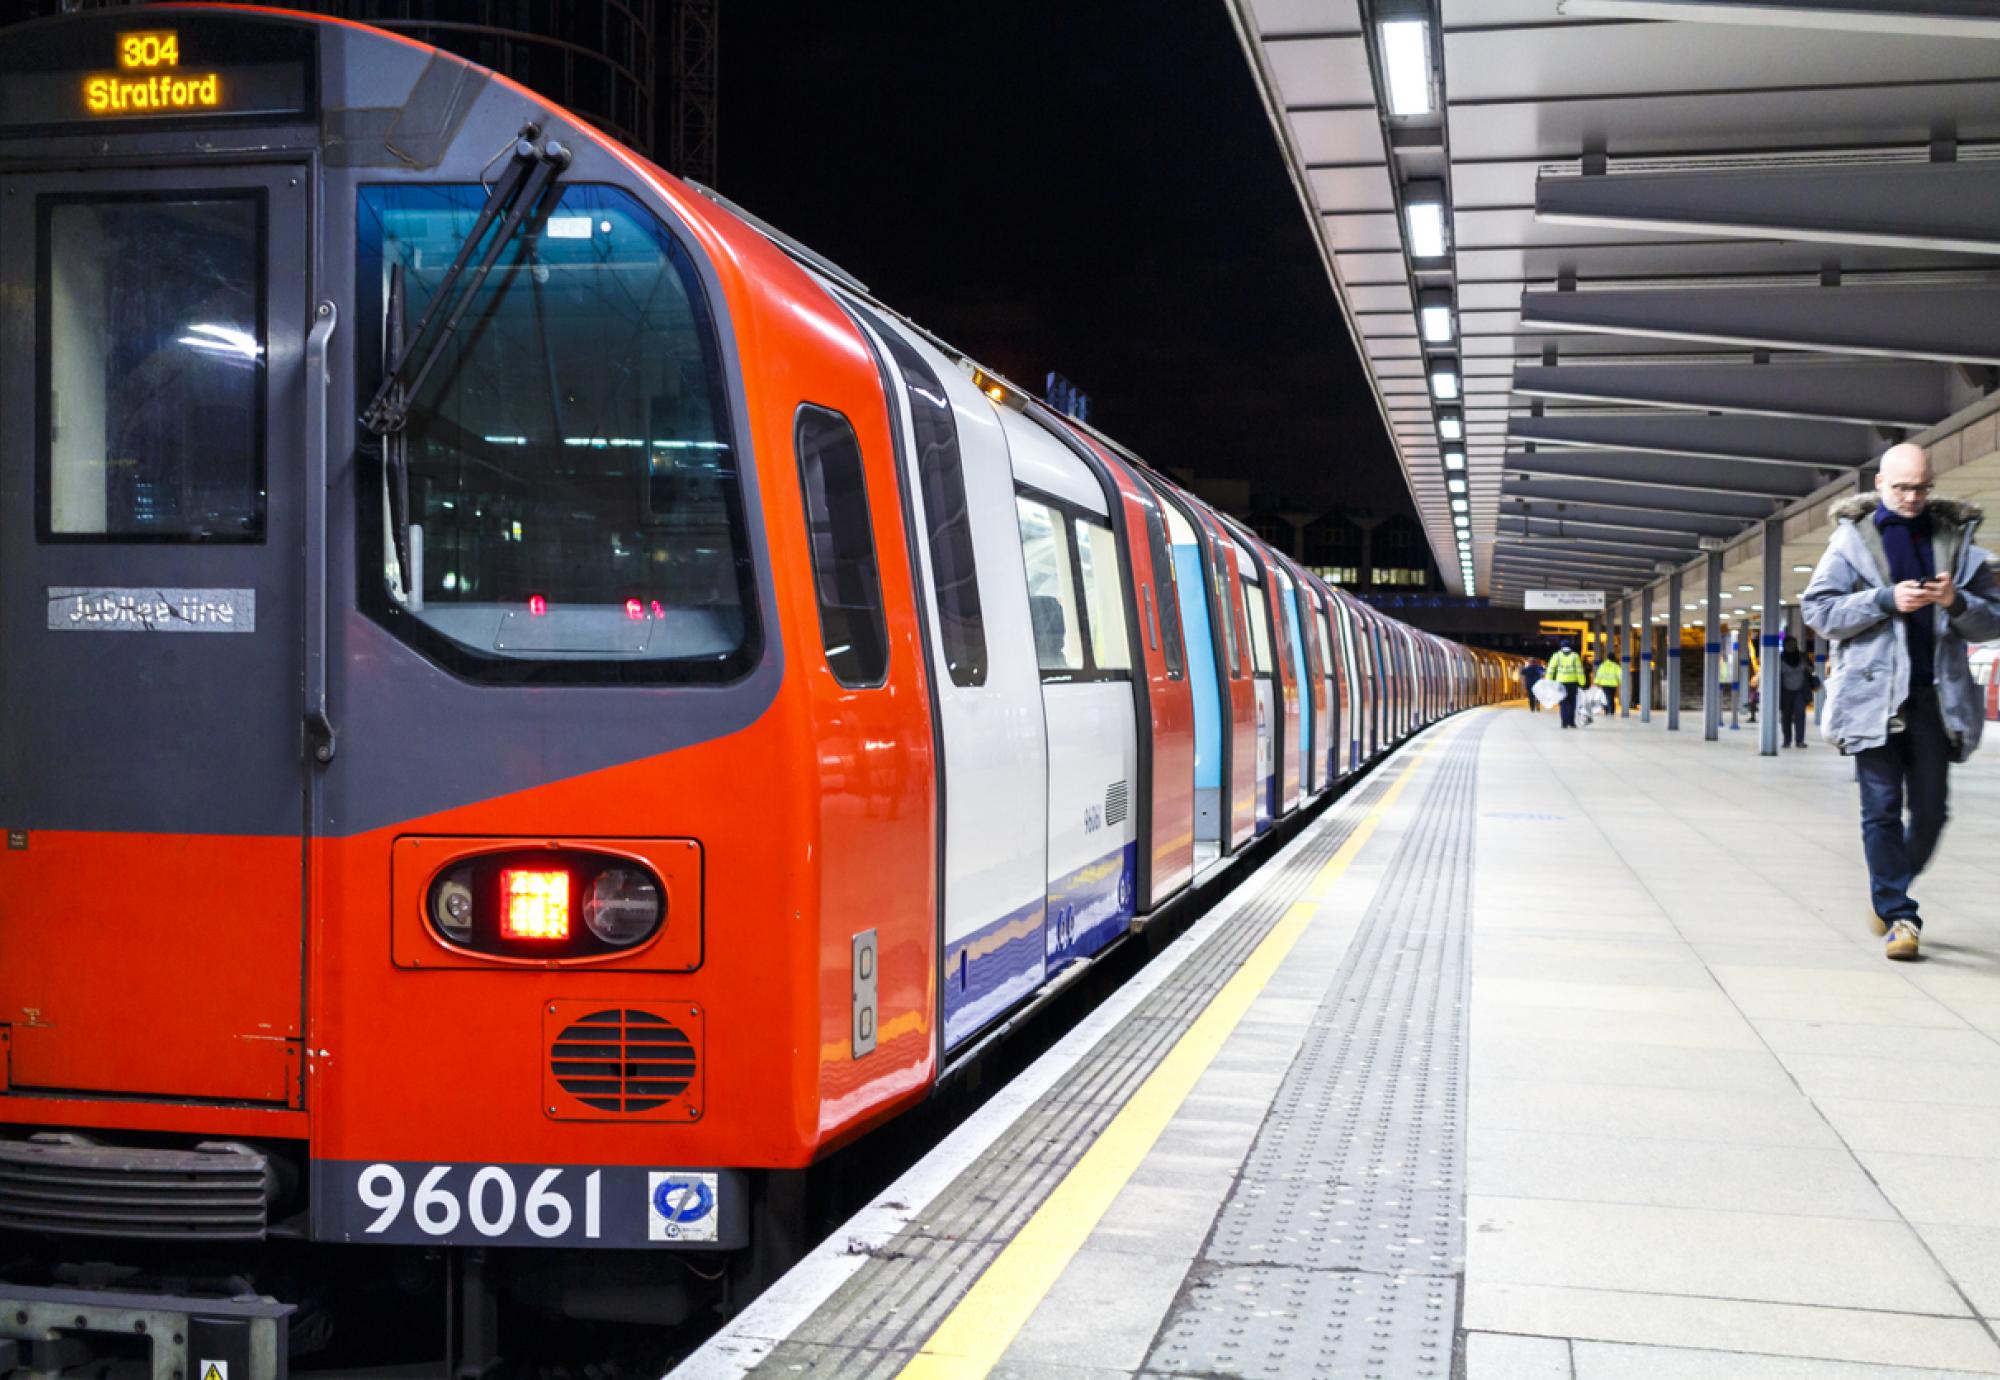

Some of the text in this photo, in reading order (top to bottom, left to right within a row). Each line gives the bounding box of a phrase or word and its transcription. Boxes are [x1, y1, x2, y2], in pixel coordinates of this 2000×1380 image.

[123, 36, 178, 67] 304
[88, 74, 217, 110] Stratford
[69, 596, 171, 622] Jubilee
[357, 1163, 601, 1239] 96061
